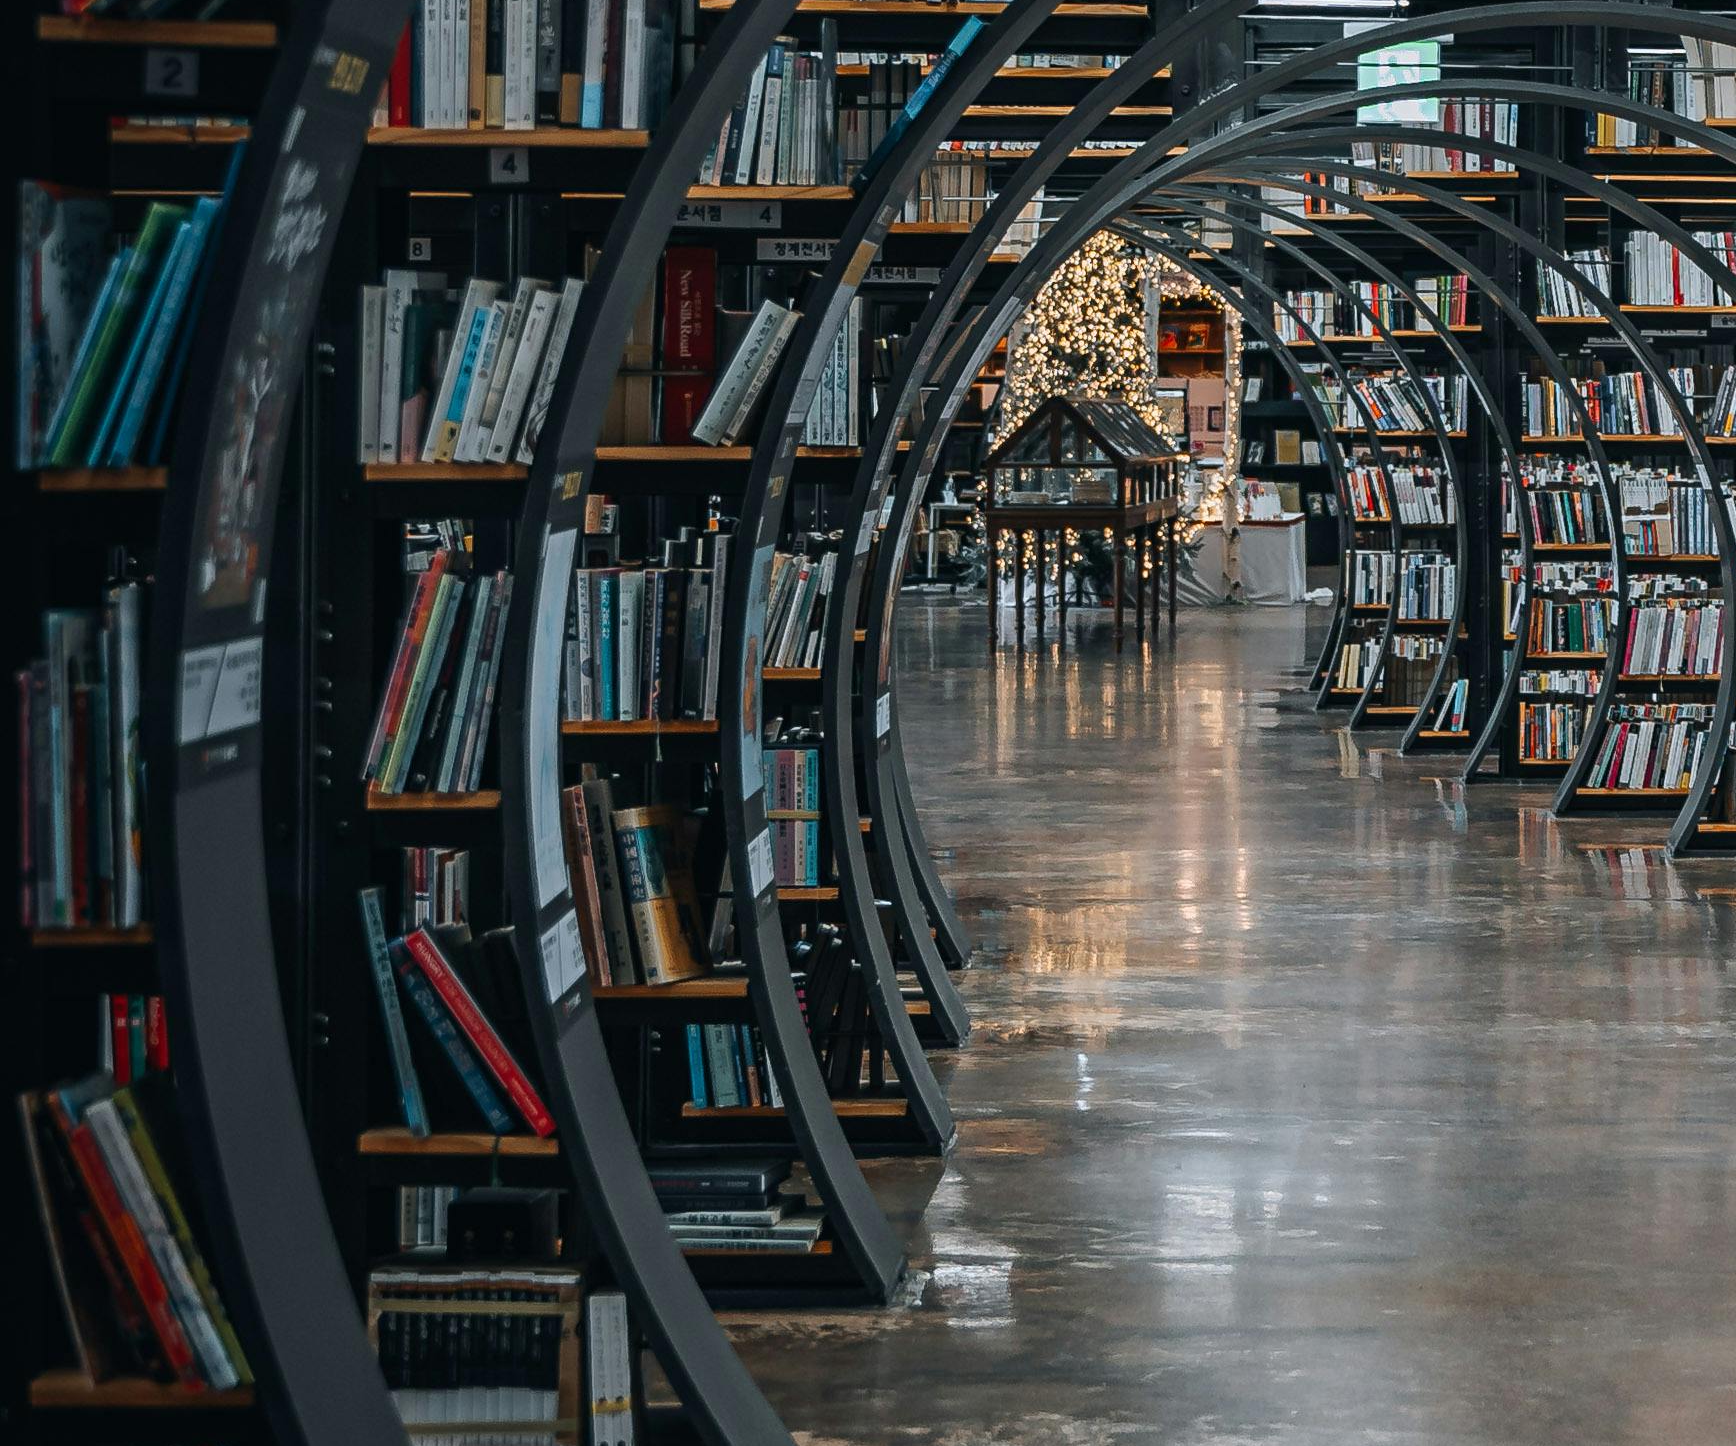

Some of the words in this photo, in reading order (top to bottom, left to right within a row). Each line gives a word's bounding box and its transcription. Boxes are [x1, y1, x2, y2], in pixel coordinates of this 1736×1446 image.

[163, 57, 183, 89] 2
[502, 155, 516, 173] 4
[759, 207, 772, 222] 4
[412, 242, 423, 256] 8
[679, 269, 693, 296] New
[679, 300, 693, 358] SilkRoad
